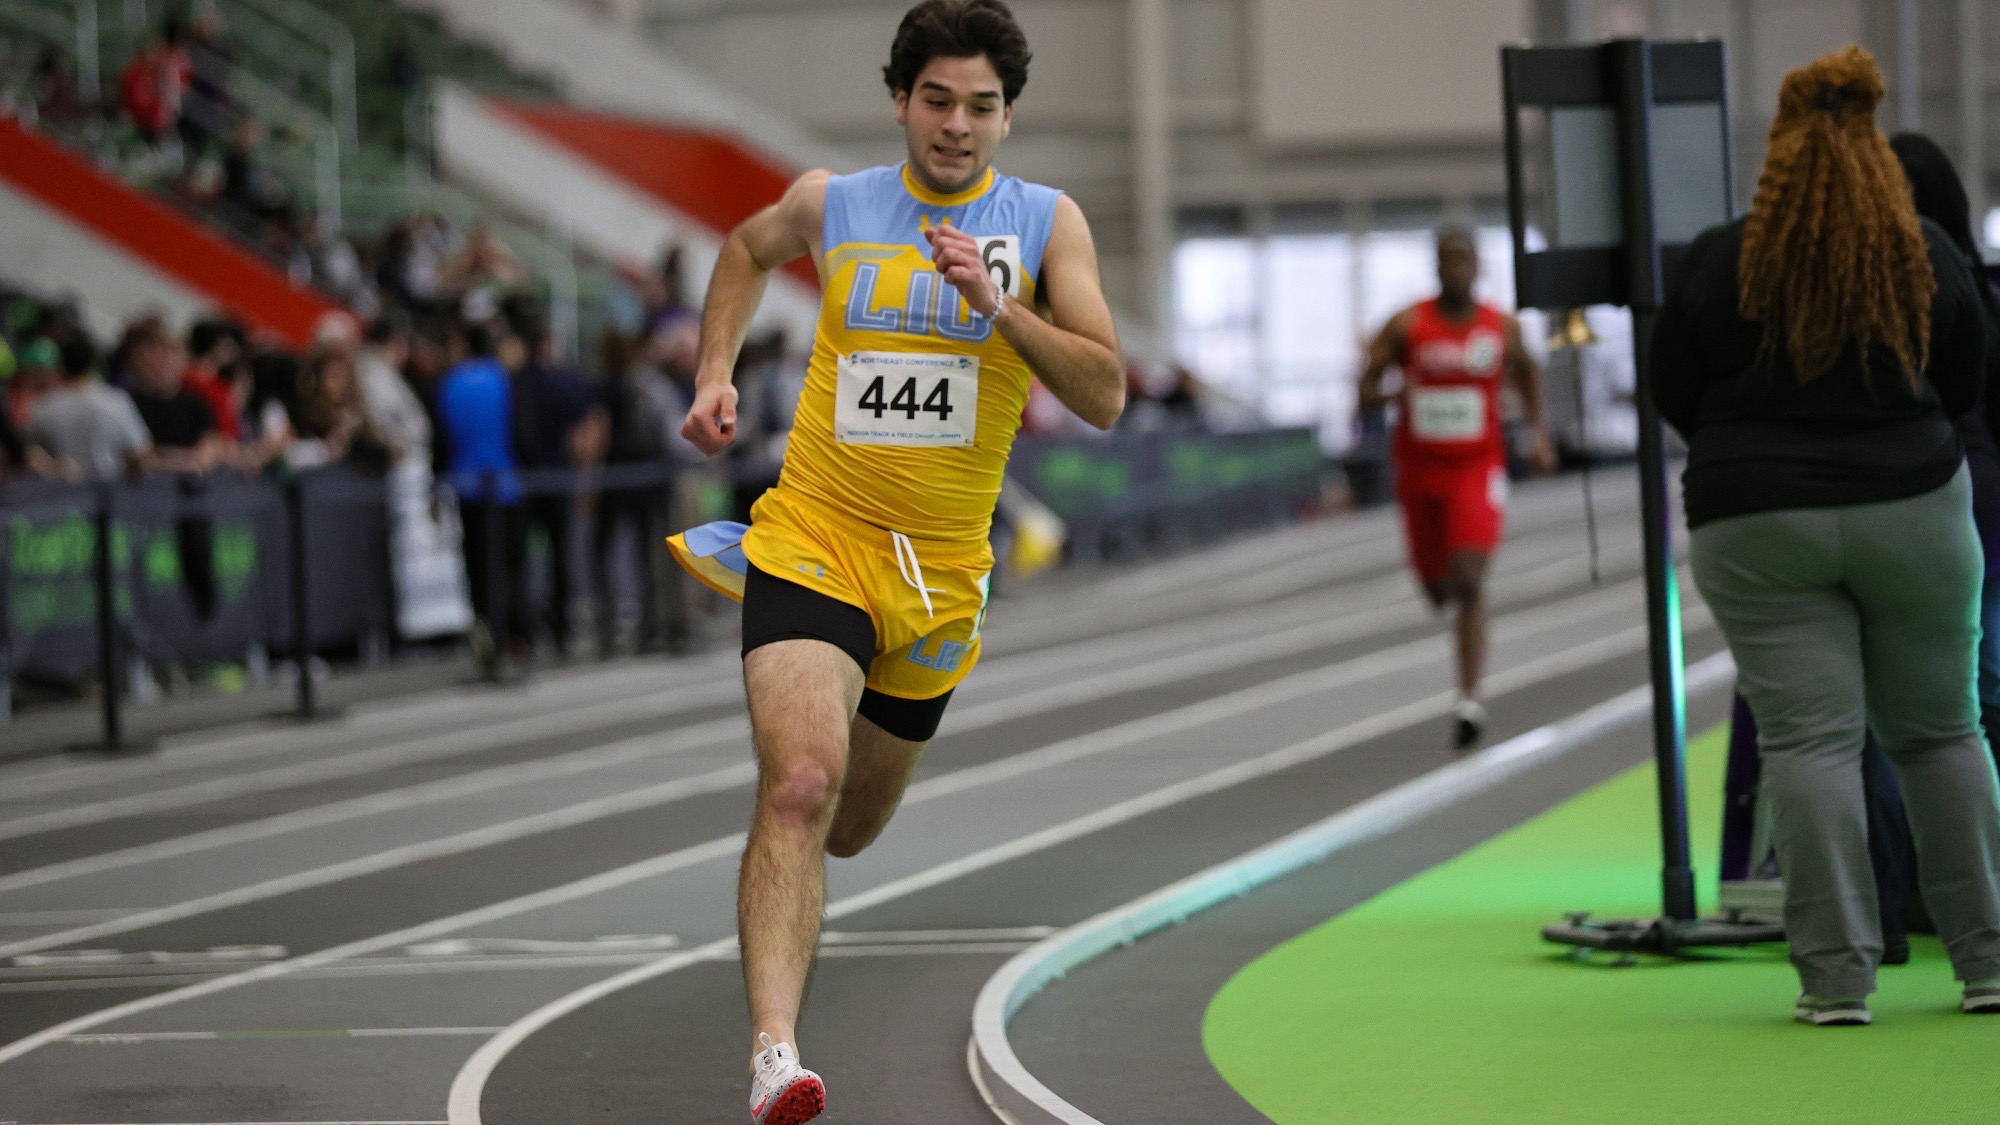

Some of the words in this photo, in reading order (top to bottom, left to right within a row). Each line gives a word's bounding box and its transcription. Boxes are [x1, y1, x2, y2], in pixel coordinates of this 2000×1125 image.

[846, 262, 993, 343] LIU
[860, 356, 903, 366] NORTHEAST
[905, 358, 955, 368] CONFERENCE
[858, 375, 953, 421] 444
